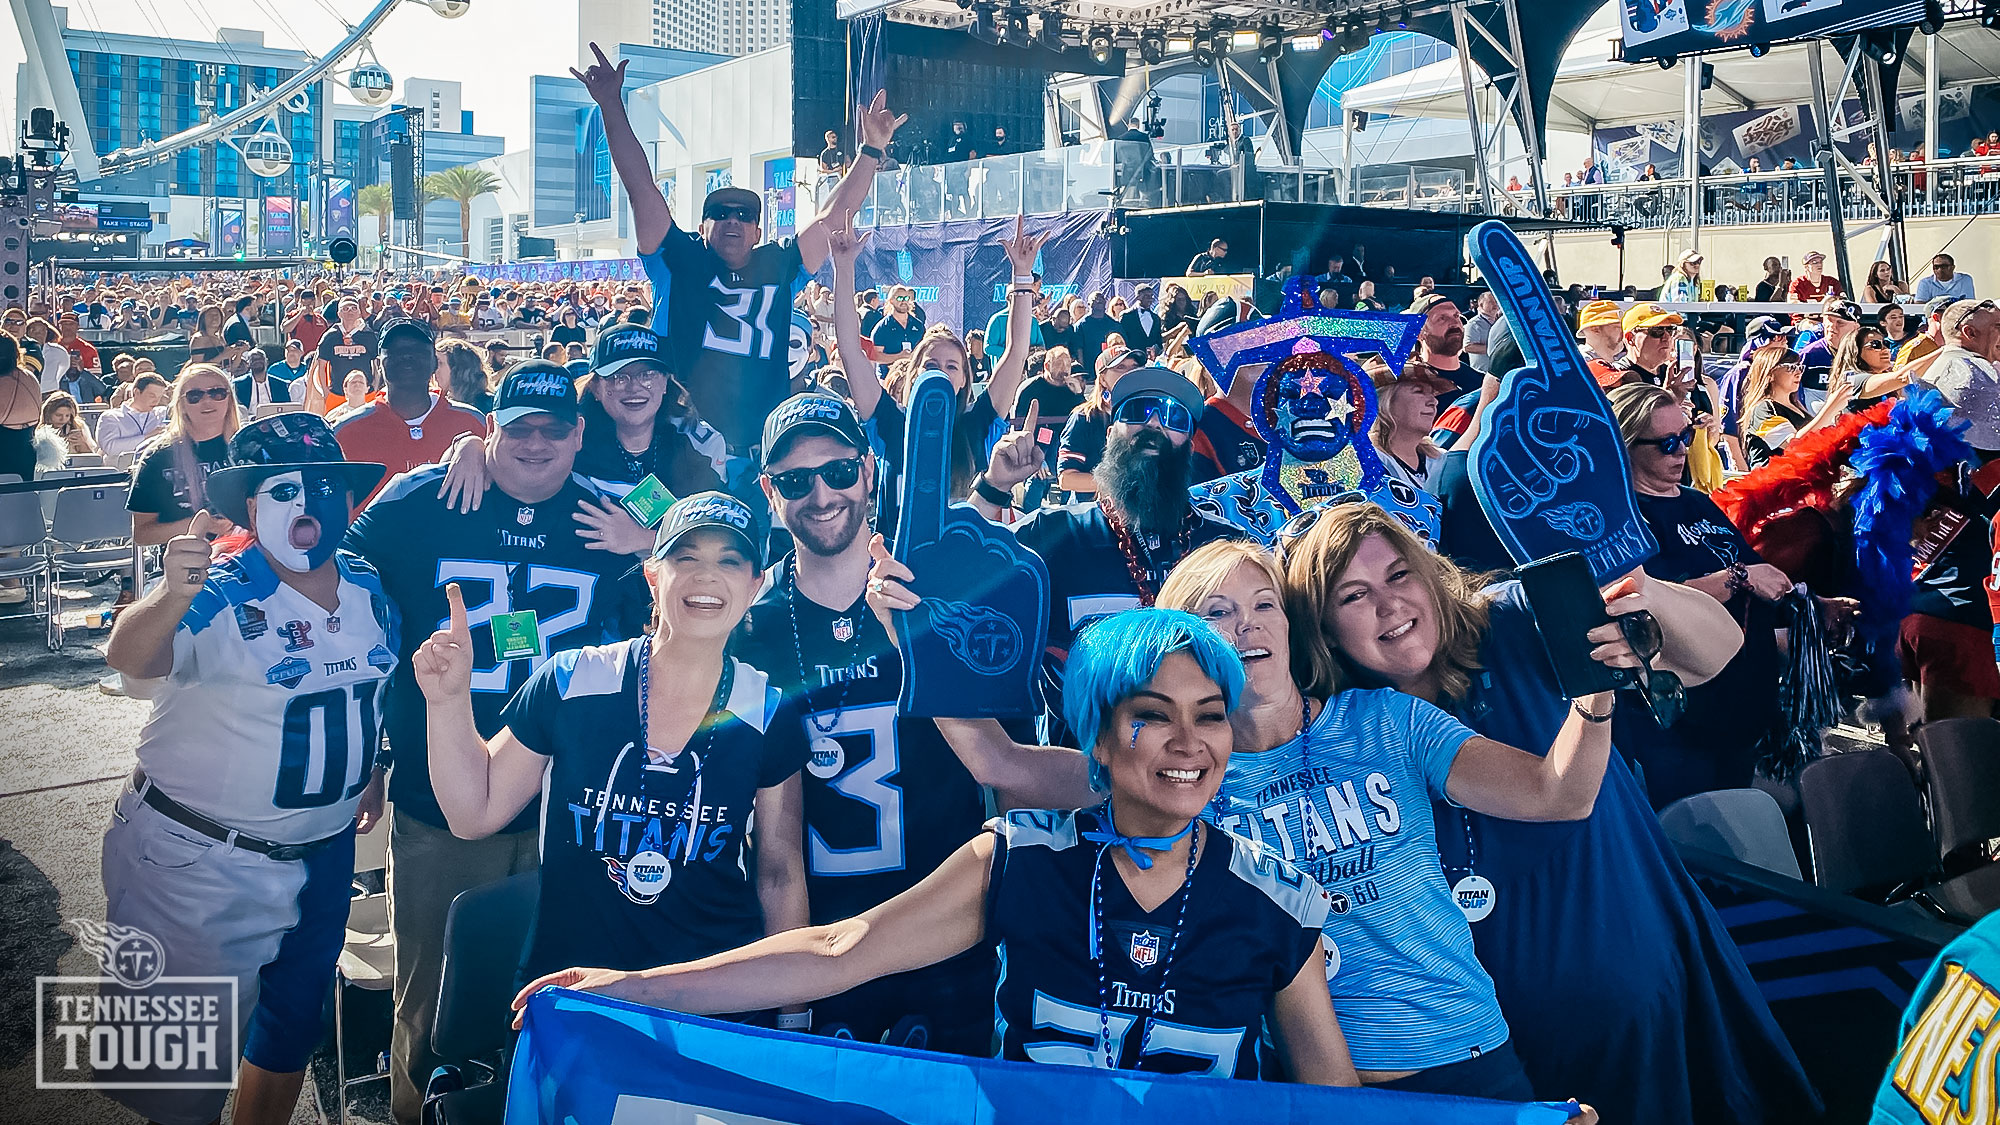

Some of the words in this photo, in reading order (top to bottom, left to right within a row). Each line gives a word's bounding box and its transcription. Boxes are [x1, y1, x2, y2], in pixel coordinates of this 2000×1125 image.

[195, 63, 226, 77] THE
[1498, 256, 1533, 298] UP
[702, 274, 779, 360] 31
[1520, 295, 1572, 378] TITAN
[497, 528, 547, 550] TITANS
[814, 655, 879, 688] TITANS
[803, 700, 906, 877] 3
[1255, 767, 1334, 805] TENNESSEE
[583, 787, 728, 823] TENNESSEE
[568, 803, 733, 862] TITANS
[633, 865, 666, 874] TITAN
[645, 873, 664, 883] UP
[1317, 845, 1379, 886] tball
[1352, 880, 1380, 906] 60
[1457, 889, 1490, 900] TITAN
[1470, 897, 1488, 909] UP
[1111, 981, 1176, 1015] TITANS
